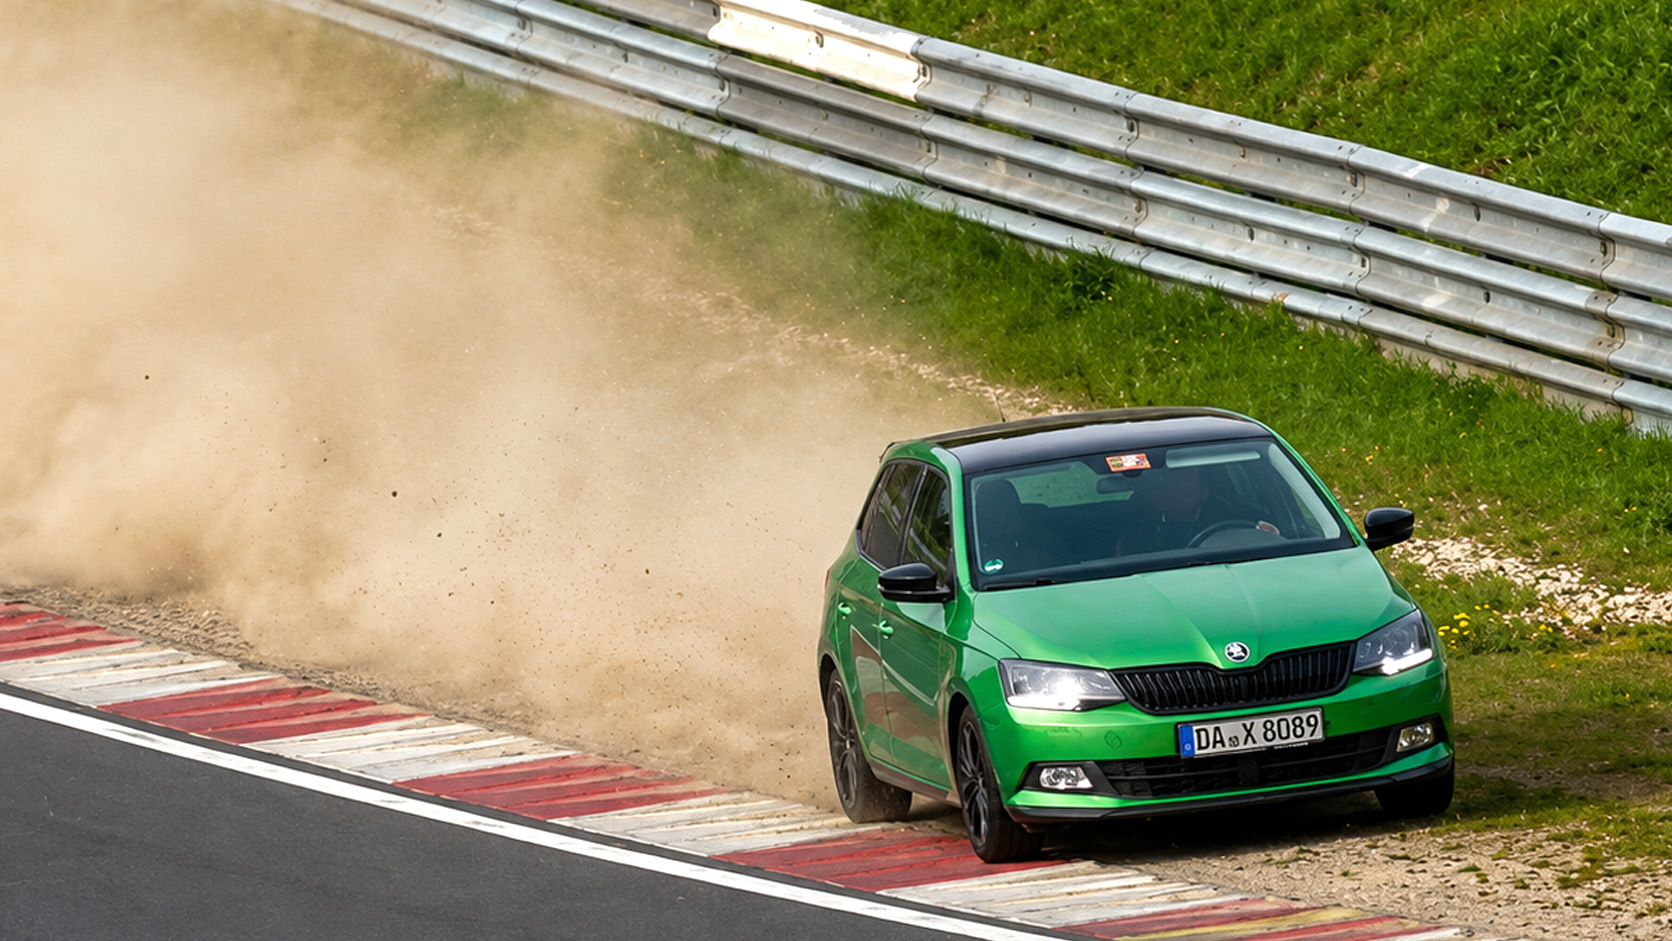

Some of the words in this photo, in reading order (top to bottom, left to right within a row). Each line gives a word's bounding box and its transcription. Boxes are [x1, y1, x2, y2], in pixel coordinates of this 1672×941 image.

[1195, 726, 1226, 751] DA
[1242, 721, 1257, 746] X
[1262, 714, 1319, 742] 8089
